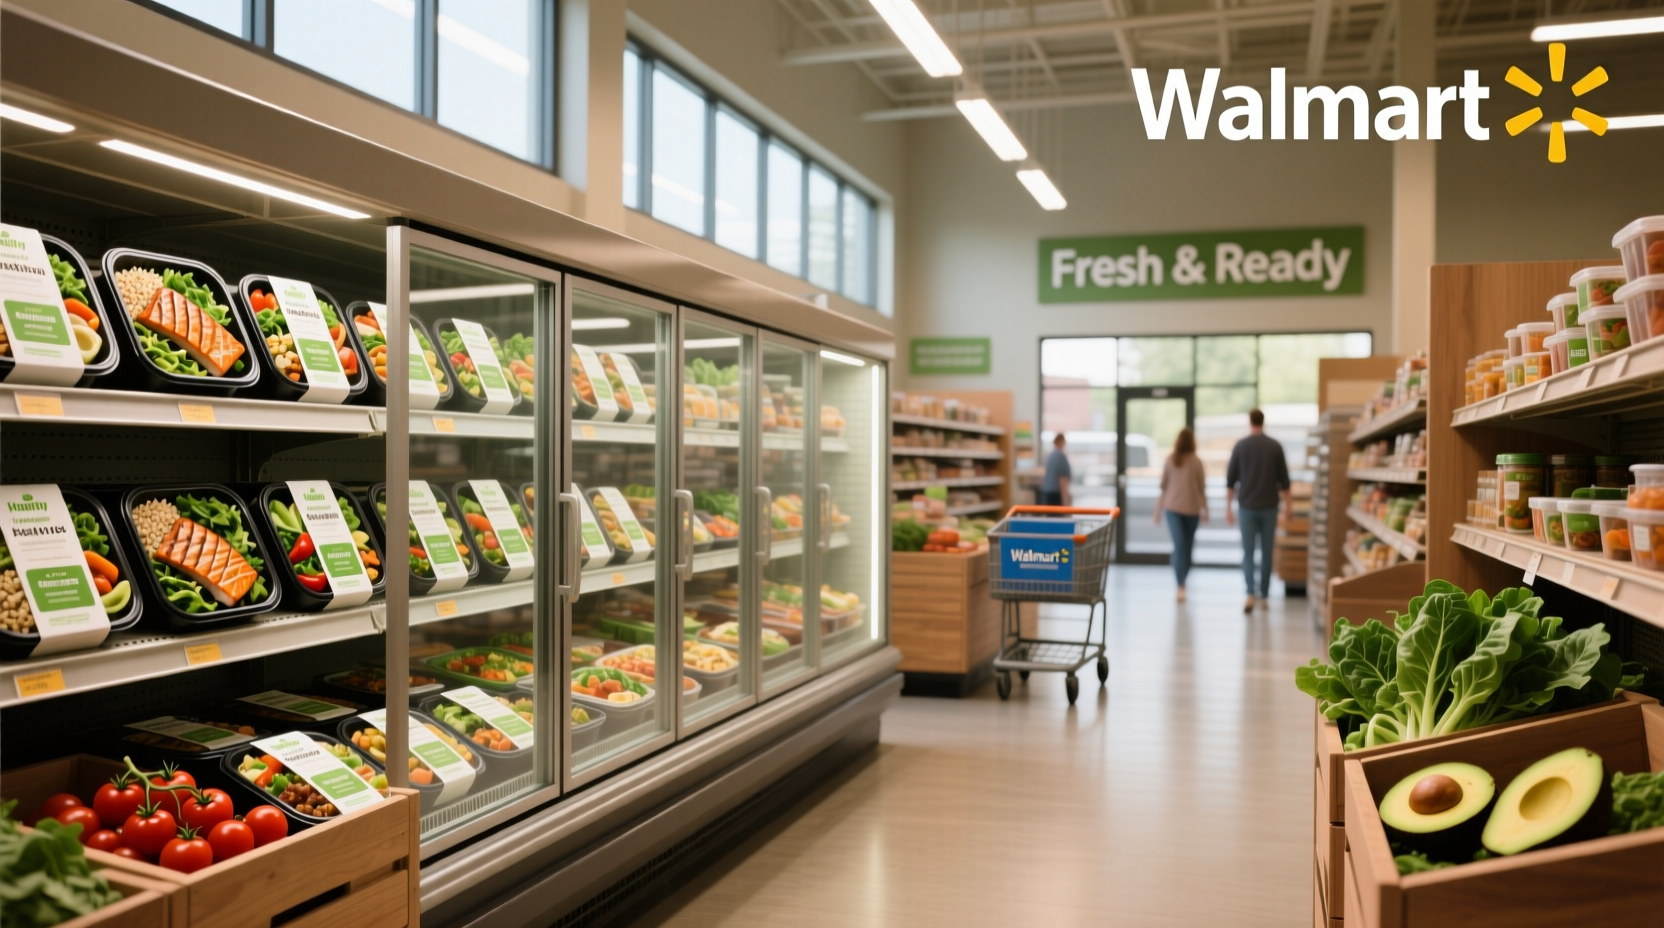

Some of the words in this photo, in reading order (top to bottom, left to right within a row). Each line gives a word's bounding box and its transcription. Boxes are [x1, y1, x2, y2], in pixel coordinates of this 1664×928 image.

[1051, 245, 1163, 289] Fresh
[1172, 243, 1207, 286] &
[1216, 238, 1351, 291] Ready
[1010, 548, 1060, 563] Walmart
